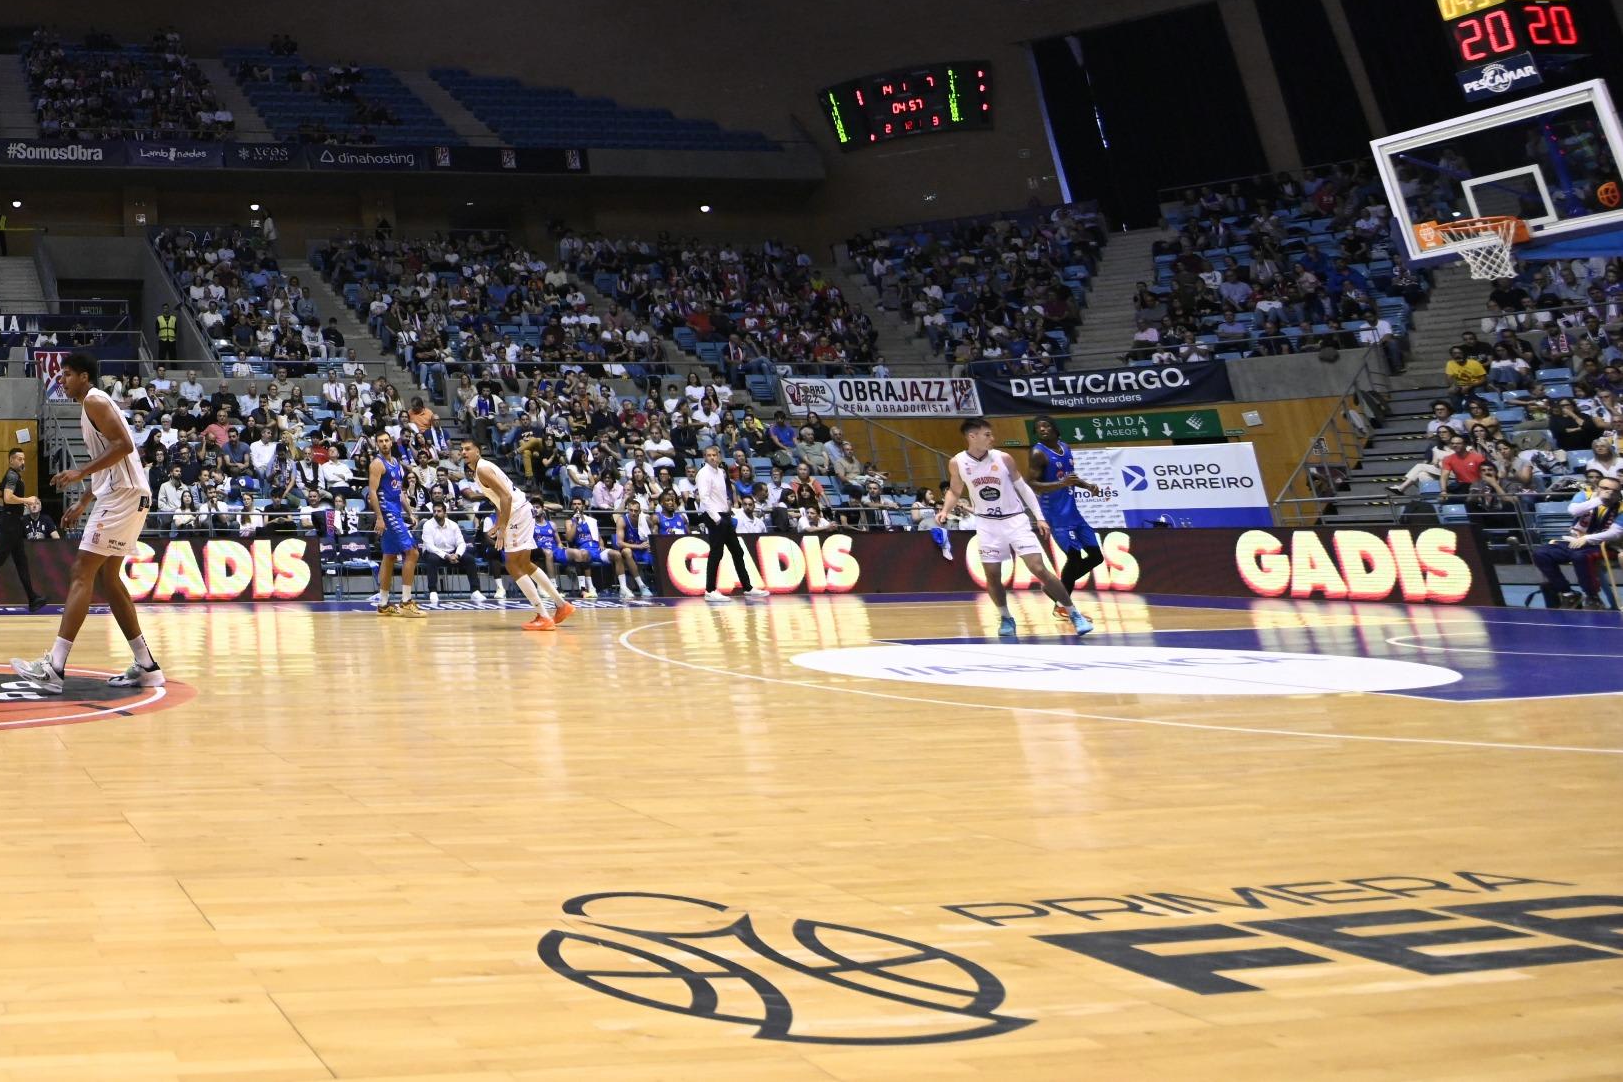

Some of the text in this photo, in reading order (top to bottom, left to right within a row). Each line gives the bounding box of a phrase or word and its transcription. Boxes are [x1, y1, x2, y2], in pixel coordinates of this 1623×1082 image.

[1524, 6, 1577, 44] 20
[1458, 10, 1516, 61] 20
[1463, 65, 1538, 93] PESCAMAR
[7, 142, 103, 161] #SomosObra
[338, 152, 415, 167] dinahosting
[839, 380, 948, 402] OBRAJAZZ
[1051, 394, 1142, 407] freight forwarders
[876, 404, 951, 414] OBRADOIRISTA
[1092, 416, 1148, 429] SAIDA
[1106, 428, 1138, 436] ASEOS
[1153, 463, 1221, 477] GRUPO
[1157, 476, 1254, 490] BARREIRO
[119, 540, 312, 602] GADIS
[1234, 527, 1473, 604] GADIS
[940, 870, 1580, 927] PRIMERA
